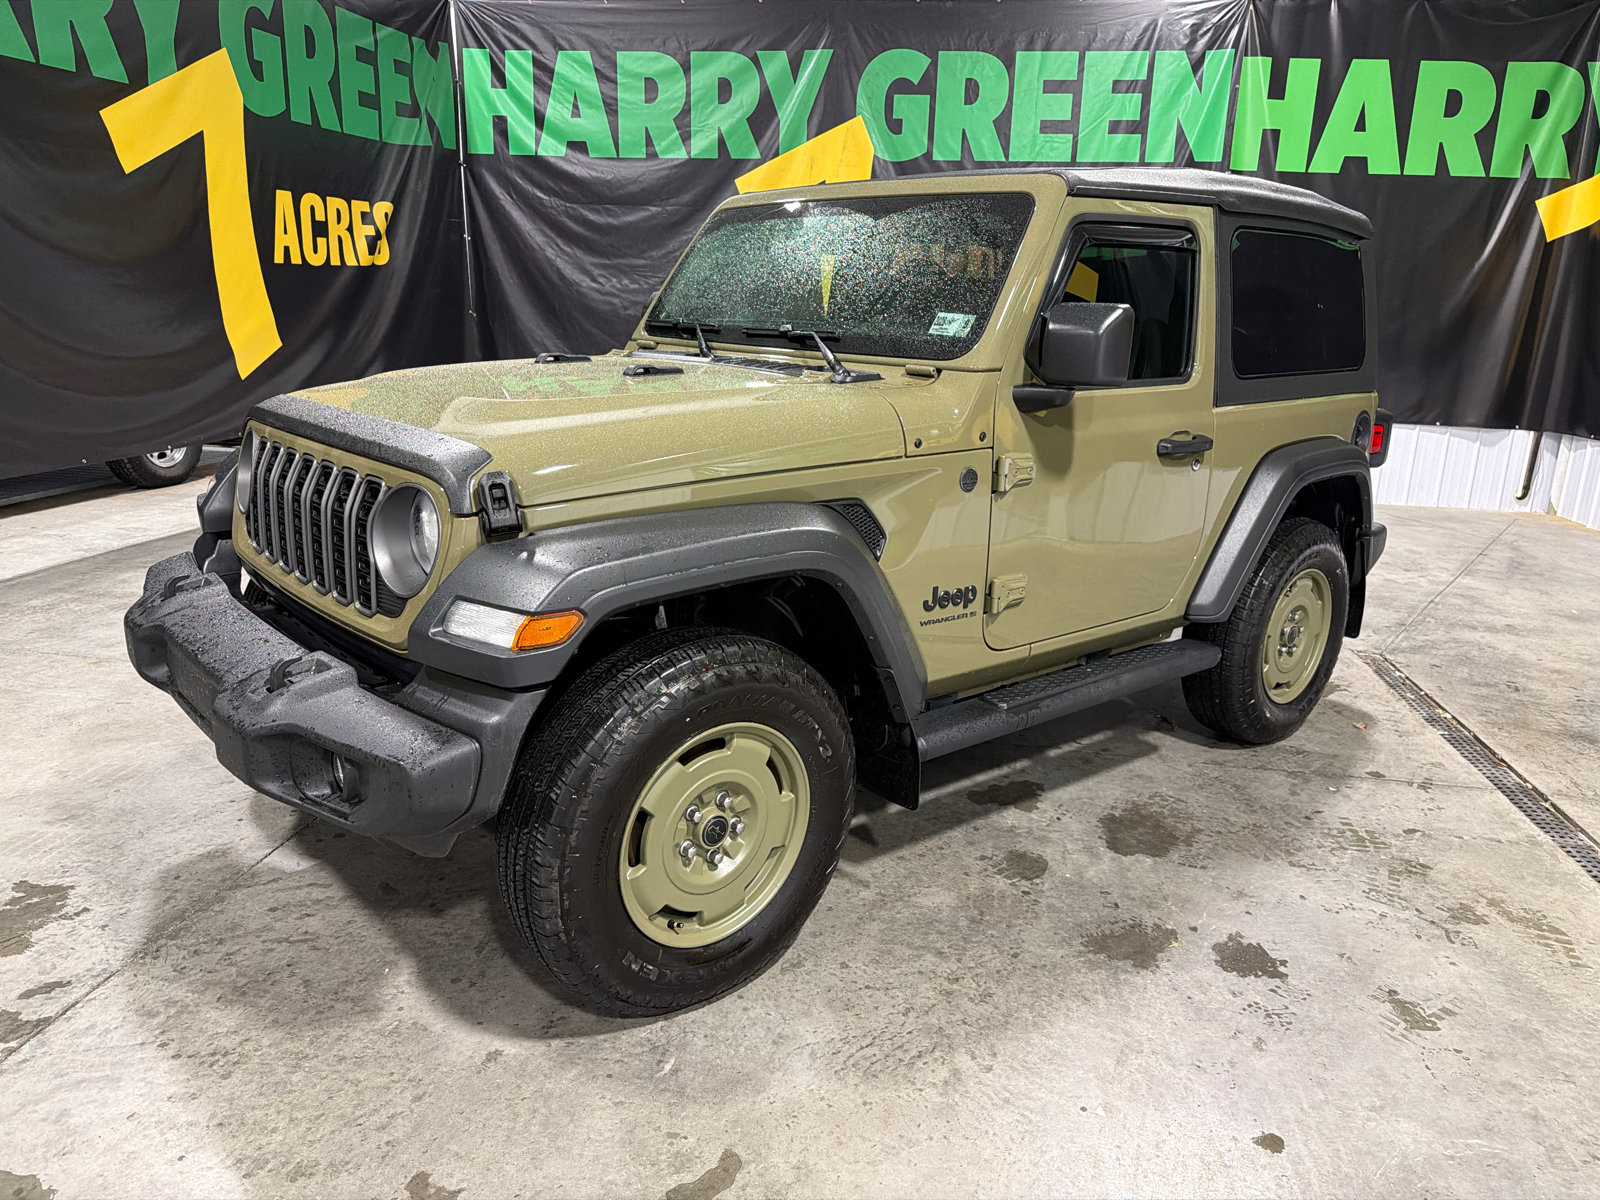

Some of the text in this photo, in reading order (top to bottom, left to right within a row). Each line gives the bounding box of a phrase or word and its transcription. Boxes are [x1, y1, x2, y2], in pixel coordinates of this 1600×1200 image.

[219, 0, 457, 150] GREEN
[463, 48, 834, 159] HARRY
[856, 48, 1236, 162] GREEN
[1230, 56, 1600, 179] HARR
[99, 47, 393, 380] 7 ACRES
[919, 612, 969, 627] WRANGLER
[923, 585, 977, 612] Jeep
